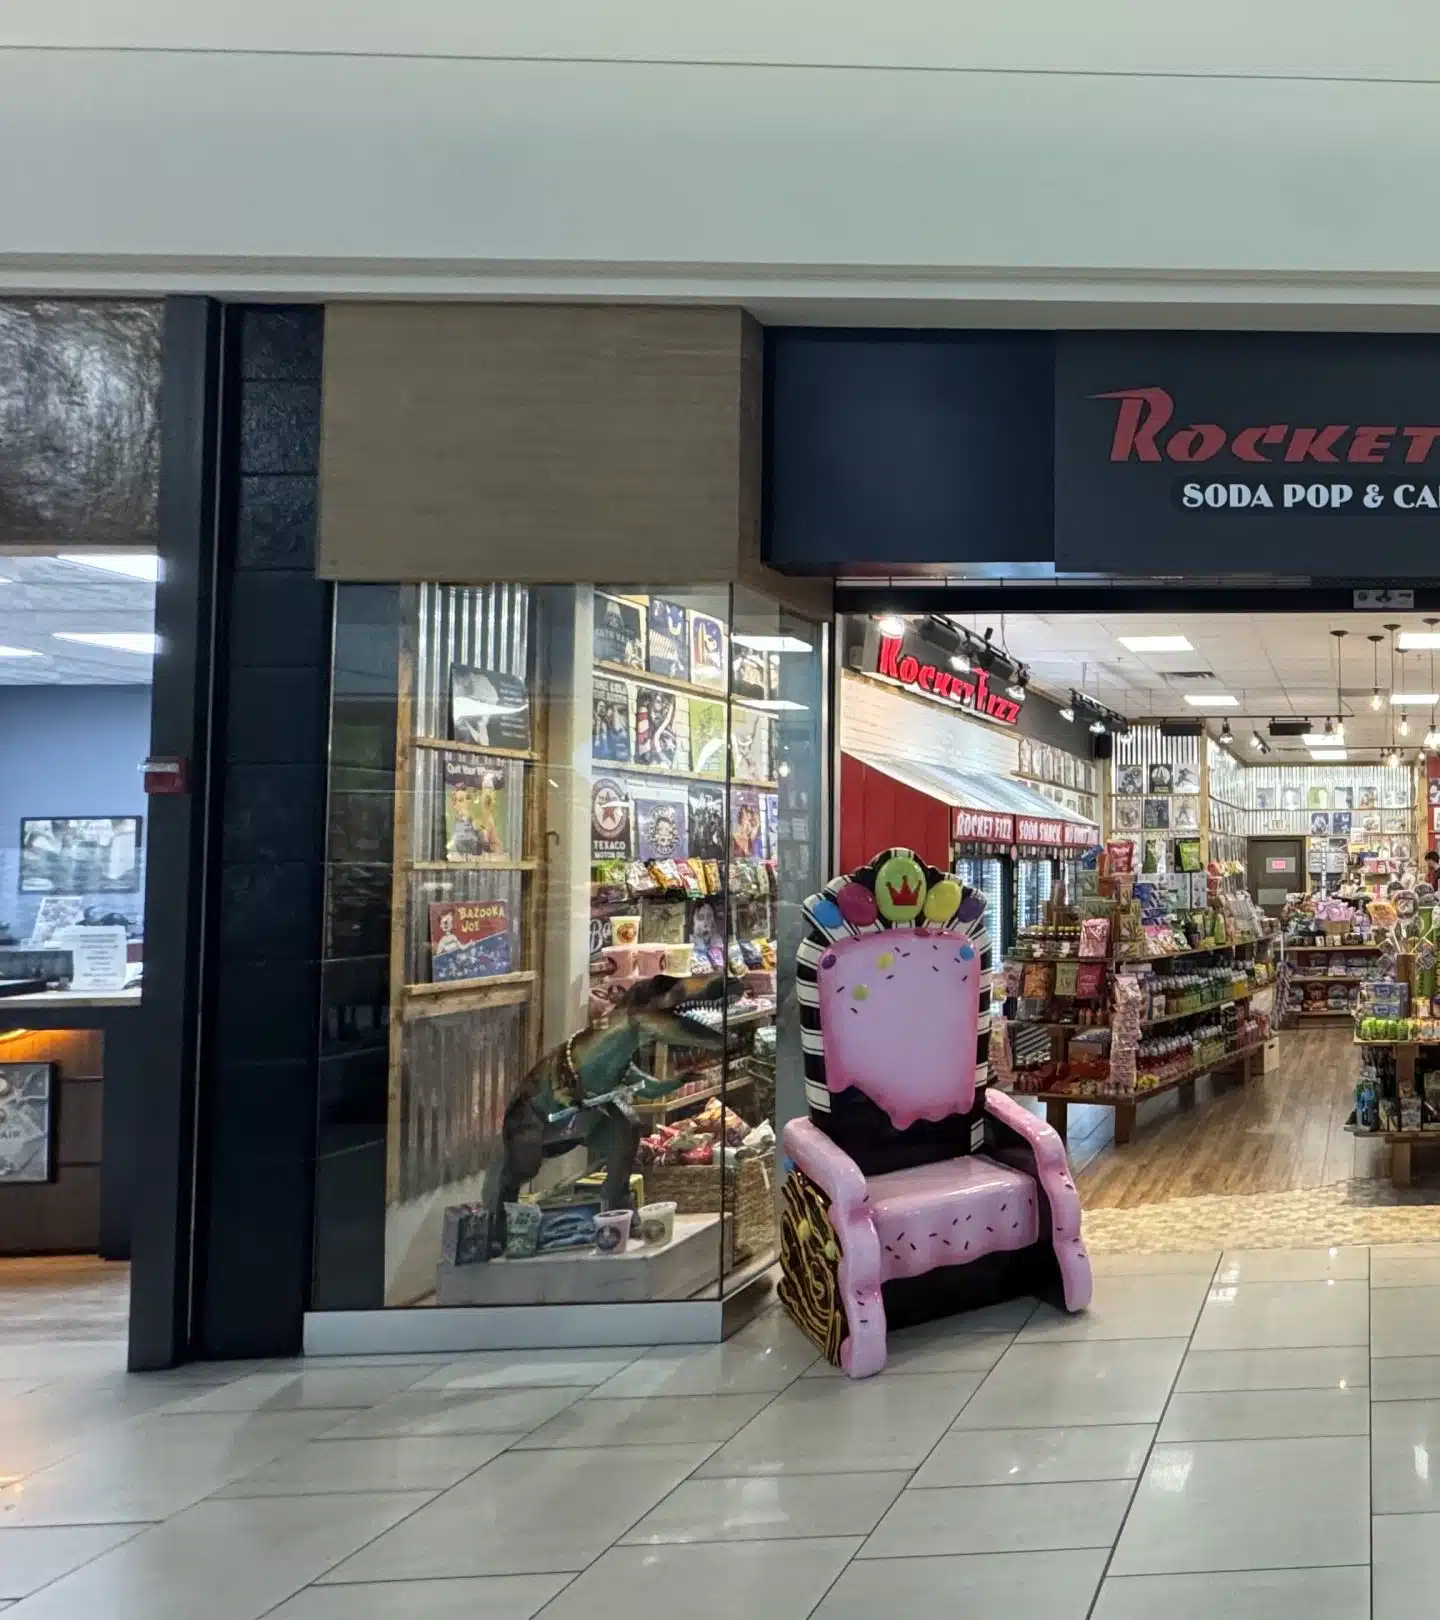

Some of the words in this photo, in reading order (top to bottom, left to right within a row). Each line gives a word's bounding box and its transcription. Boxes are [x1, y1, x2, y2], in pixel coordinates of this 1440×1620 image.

[1181, 482, 1275, 509] SODA
[1282, 483, 1354, 509] POP
[1362, 483, 1385, 509] &
[956, 810, 994, 837] ROCKET
[994, 817, 1013, 840] FIZZ
[1019, 819, 1038, 841] SODA
[594, 839, 626, 850] TEXACO
[457, 904, 505, 920] BAZOOKA
[461, 919, 480, 933] JOE
